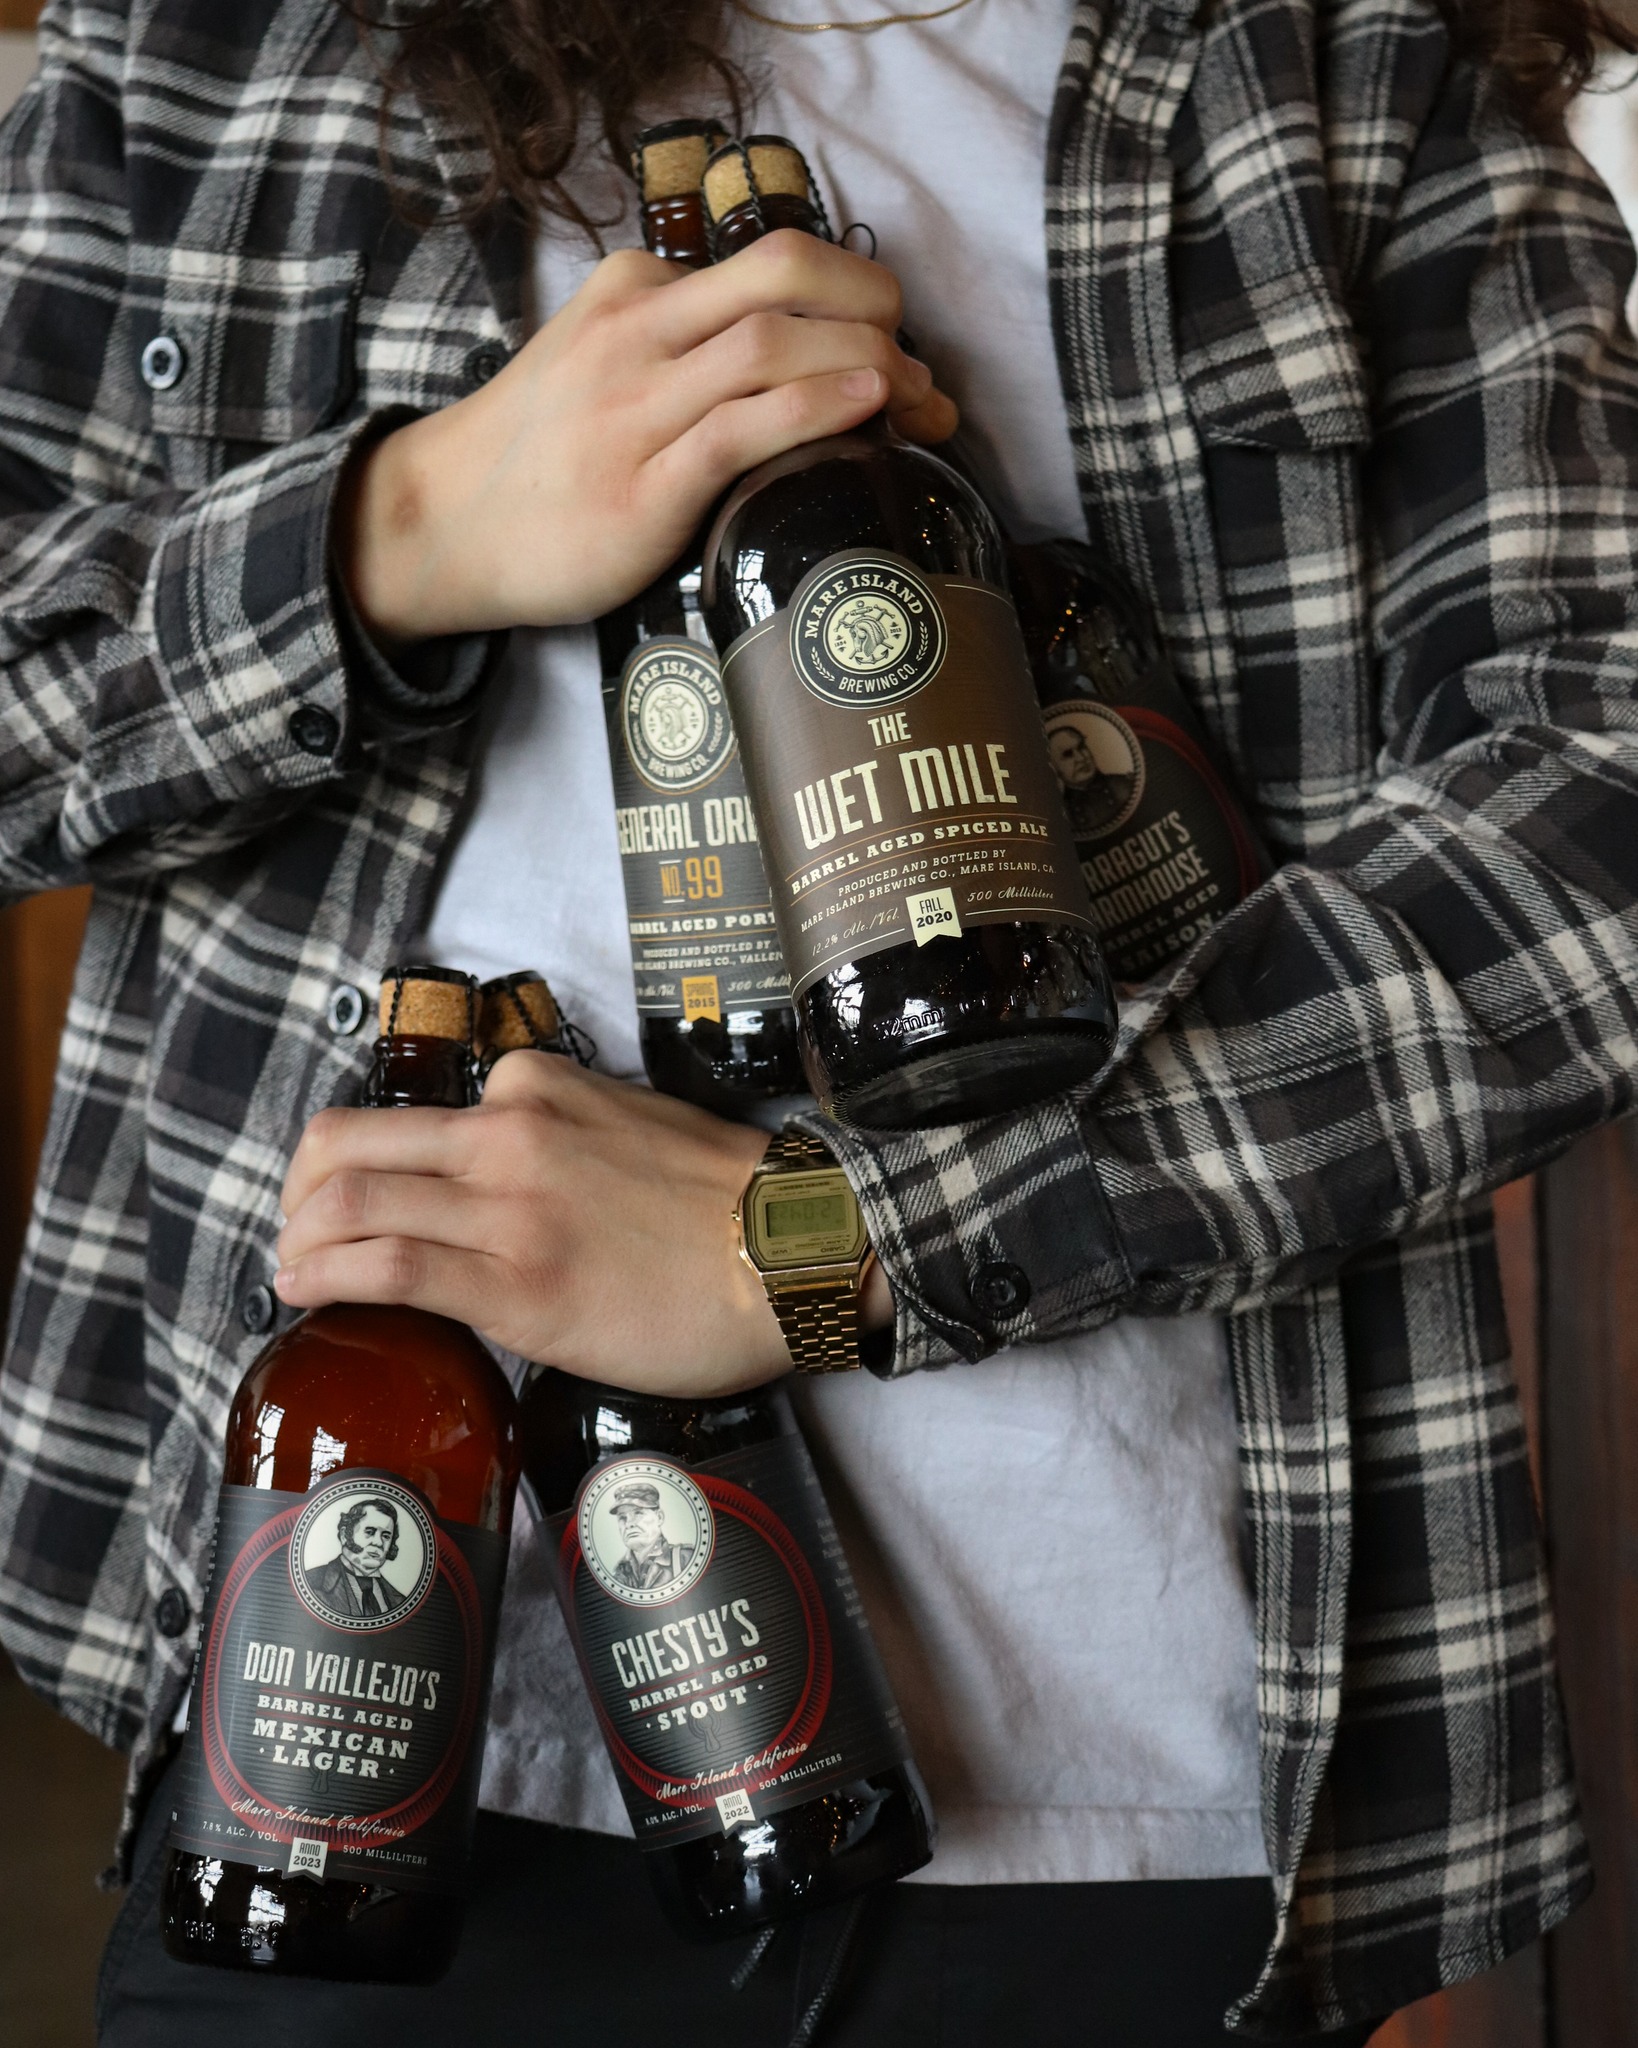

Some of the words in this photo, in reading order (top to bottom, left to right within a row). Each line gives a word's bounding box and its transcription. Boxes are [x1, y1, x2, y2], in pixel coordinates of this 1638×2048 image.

[805, 580, 848, 638] MARE
[850, 574, 923, 614] ISLAND
[630, 663, 661, 714] MARE
[662, 662, 721, 705] ISLAND
[838, 673, 898, 693] BREWING
[897, 663, 918, 680] CO.
[868, 712, 911, 746] THE
[794, 760, 883, 850] WET
[899, 744, 1018, 813] MILE
[792, 852, 859, 894] BARREL
[867, 832, 924, 858] AGED
[934, 822, 1012, 839] SPICED
[1020, 822, 1048, 836] ALE
[838, 868, 898, 896] PRODUCED
[902, 860, 928, 874] AND
[933, 850, 988, 866] BOTTLED
[993, 850, 1006, 858] BY
[686, 856, 723, 900] 99
[968, 891, 992, 902] 500
[998, 886, 1054, 898] Milliliters
[801, 912, 823, 932] MARE
[826, 894, 864, 916] ISLAND
[869, 874, 926, 898] BREWING
[930, 870, 955, 880] CO.,
[960, 863, 994, 874] MARE
[999, 862, 1040, 872] ISLAND,
[920, 897, 944, 914] FALL
[672, 918, 718, 932] AGED
[916, 911, 952, 928] 2020
[681, 946, 700, 956] AND
[704, 942, 752, 954] BOTTLED
[756, 940, 771, 949] BY
[688, 997, 715, 1008] 2015
[612, 1599, 760, 1688] CHESTY'S
[244, 1642, 294, 1686] DON
[305, 1650, 440, 1710] VALLEJO'S
[629, 1678, 703, 1712] BARREL
[711, 1655, 768, 1684] AGED
[258, 1694, 344, 1720] BARREL
[354, 1710, 413, 1731] AGED
[657, 1686, 747, 1731] STOUT
[252, 1718, 410, 1760] MEXICAN
[272, 1745, 379, 1778] LAGER
[656, 1782, 687, 1800] Mare
[690, 1762, 739, 1790] Island,
[744, 1742, 808, 1775] California
[759, 1778, 777, 1790] 500
[780, 1753, 842, 1782] MILLILITERS
[232, 1798, 272, 1816] Mare
[275, 1805, 332, 1827] Island,
[337, 1814, 406, 1838] California
[723, 1794, 742, 1810] ANNO
[724, 1806, 750, 1820] 2022
[202, 1821, 221, 1832] 7.8%
[293, 1856, 320, 1868] 2023
[299, 1842, 320, 1856] ANNO
[343, 1844, 362, 1855] 500
[366, 1848, 428, 1865] MILLILITERS
